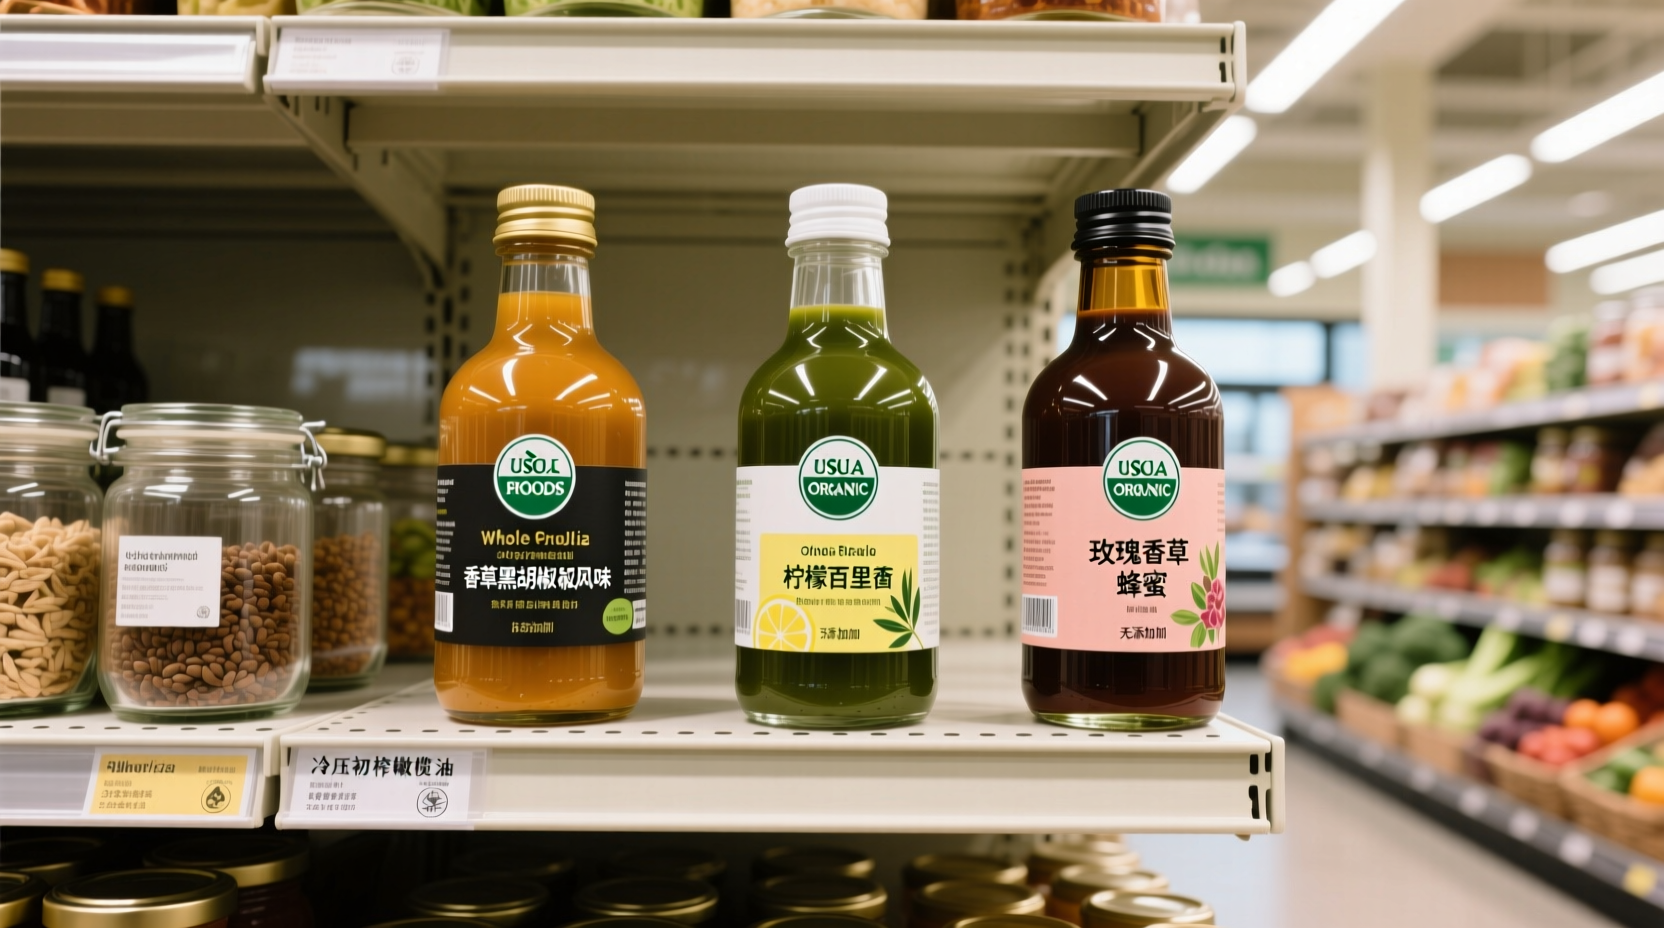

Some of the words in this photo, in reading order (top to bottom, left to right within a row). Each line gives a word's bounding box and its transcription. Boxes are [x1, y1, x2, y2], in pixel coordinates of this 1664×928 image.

[481, 530, 530, 546] Whole
[1089, 538, 1189, 566] 玫瑰香草
[1116, 569, 1168, 599] 蜂蜜
